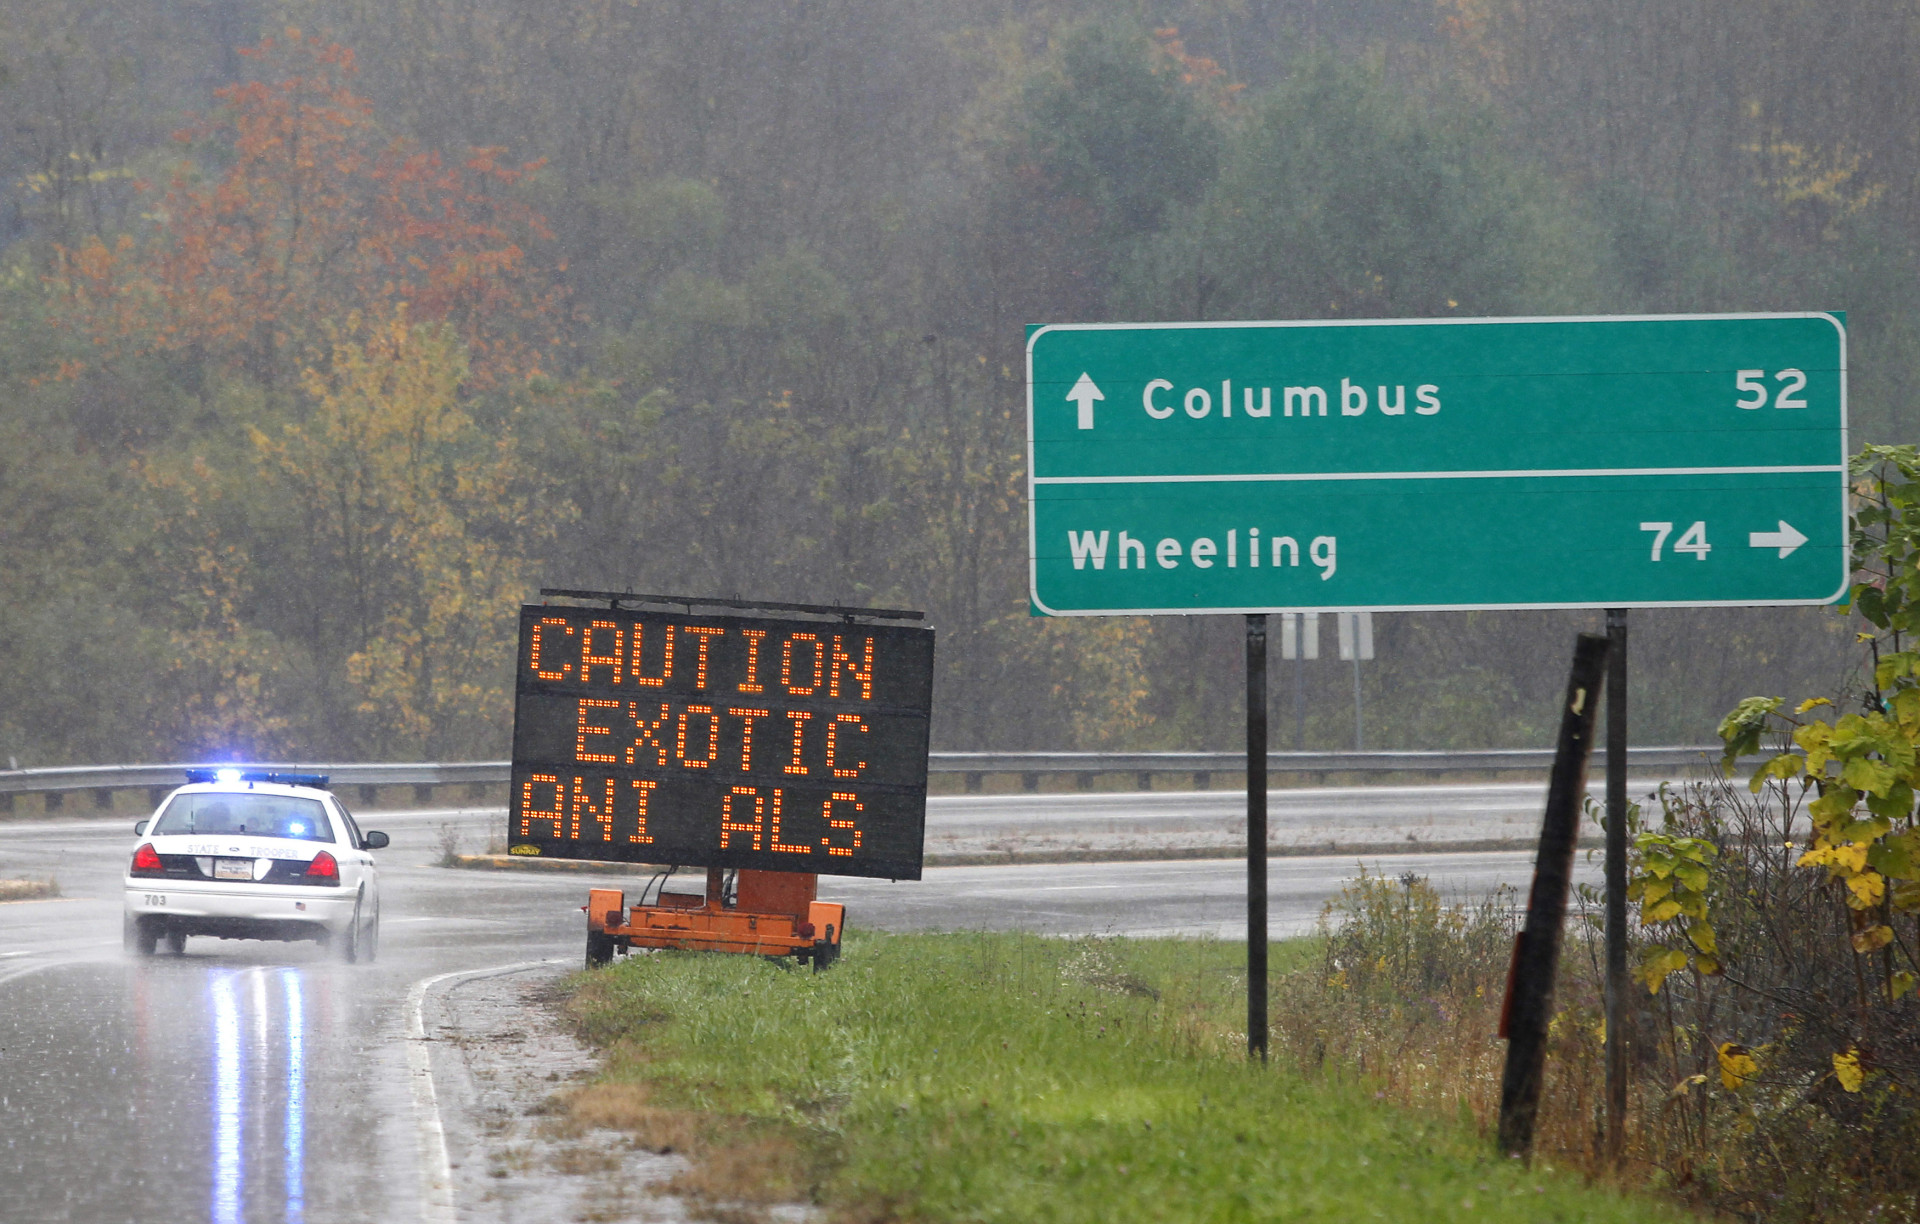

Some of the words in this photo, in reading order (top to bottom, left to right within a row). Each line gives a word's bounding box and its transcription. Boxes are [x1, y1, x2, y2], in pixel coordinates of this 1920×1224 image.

[1142, 377, 1441, 420] Columbus
[1735, 368, 1808, 410] 52
[1067, 527, 1337, 581] Wheeling
[1639, 521, 1712, 562] 74
[531, 617, 873, 700] CAUTION
[576, 698, 869, 778] EXOTIC
[187, 844, 220, 855] STATE
[250, 846, 299, 859] TROOPER
[510, 847, 541, 856] SUNRAY
[144, 894, 167, 906] 703
